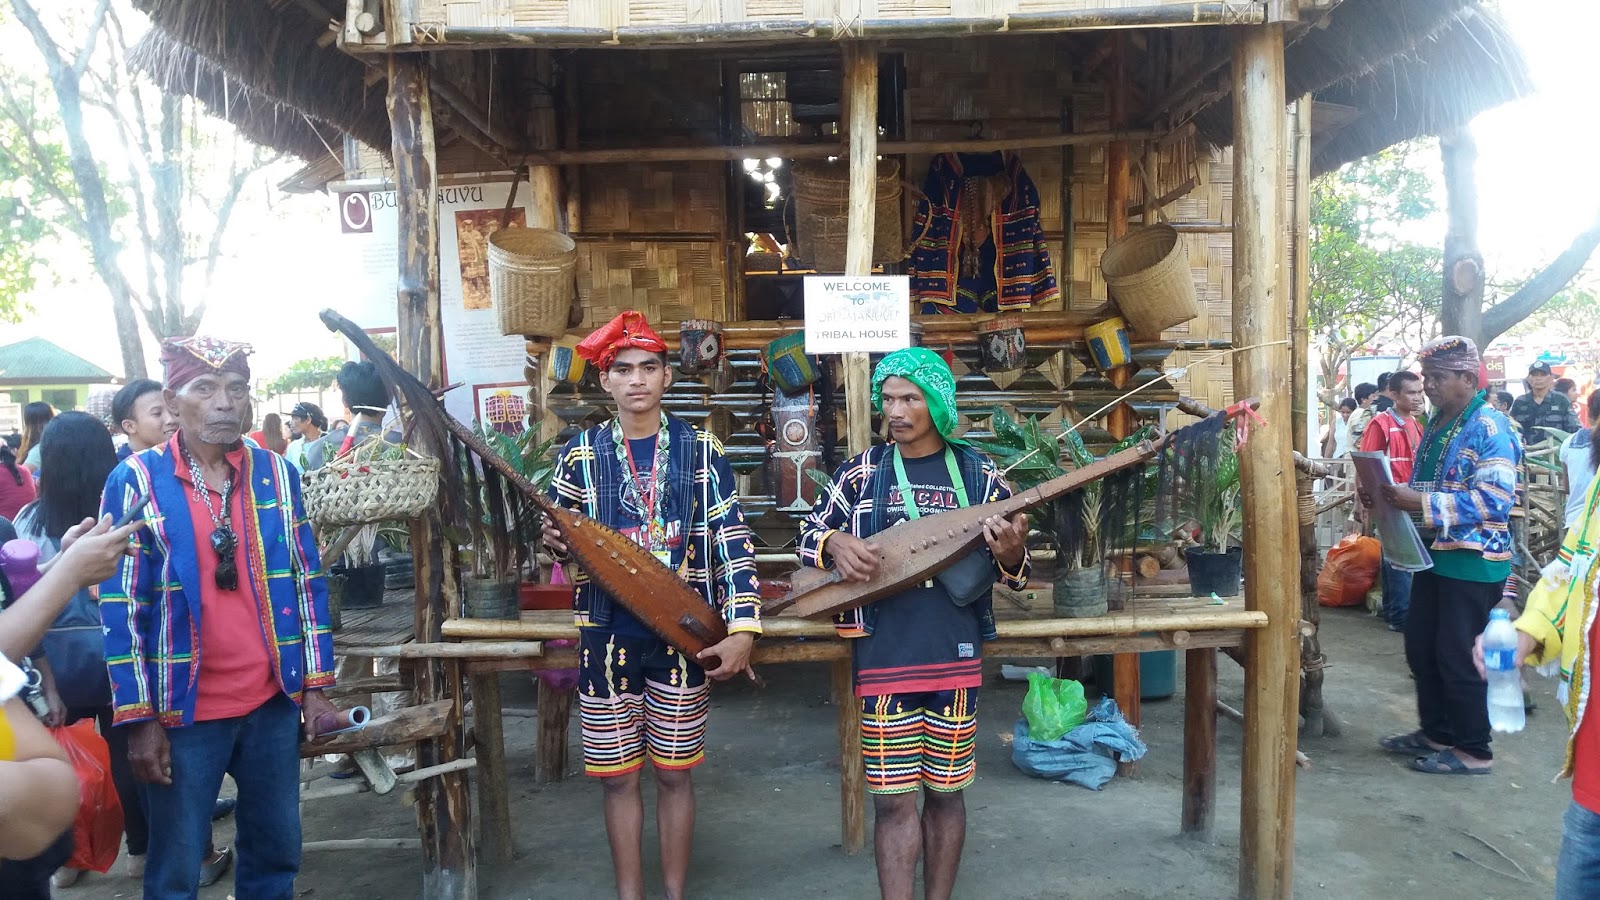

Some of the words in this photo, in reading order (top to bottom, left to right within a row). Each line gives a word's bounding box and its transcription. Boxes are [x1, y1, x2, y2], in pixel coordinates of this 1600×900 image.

[823, 282, 891, 291] WELCOME
[850, 297, 865, 306] TO
[815, 331, 856, 339] TRIBAL
[859, 330, 898, 338] HOUSE
